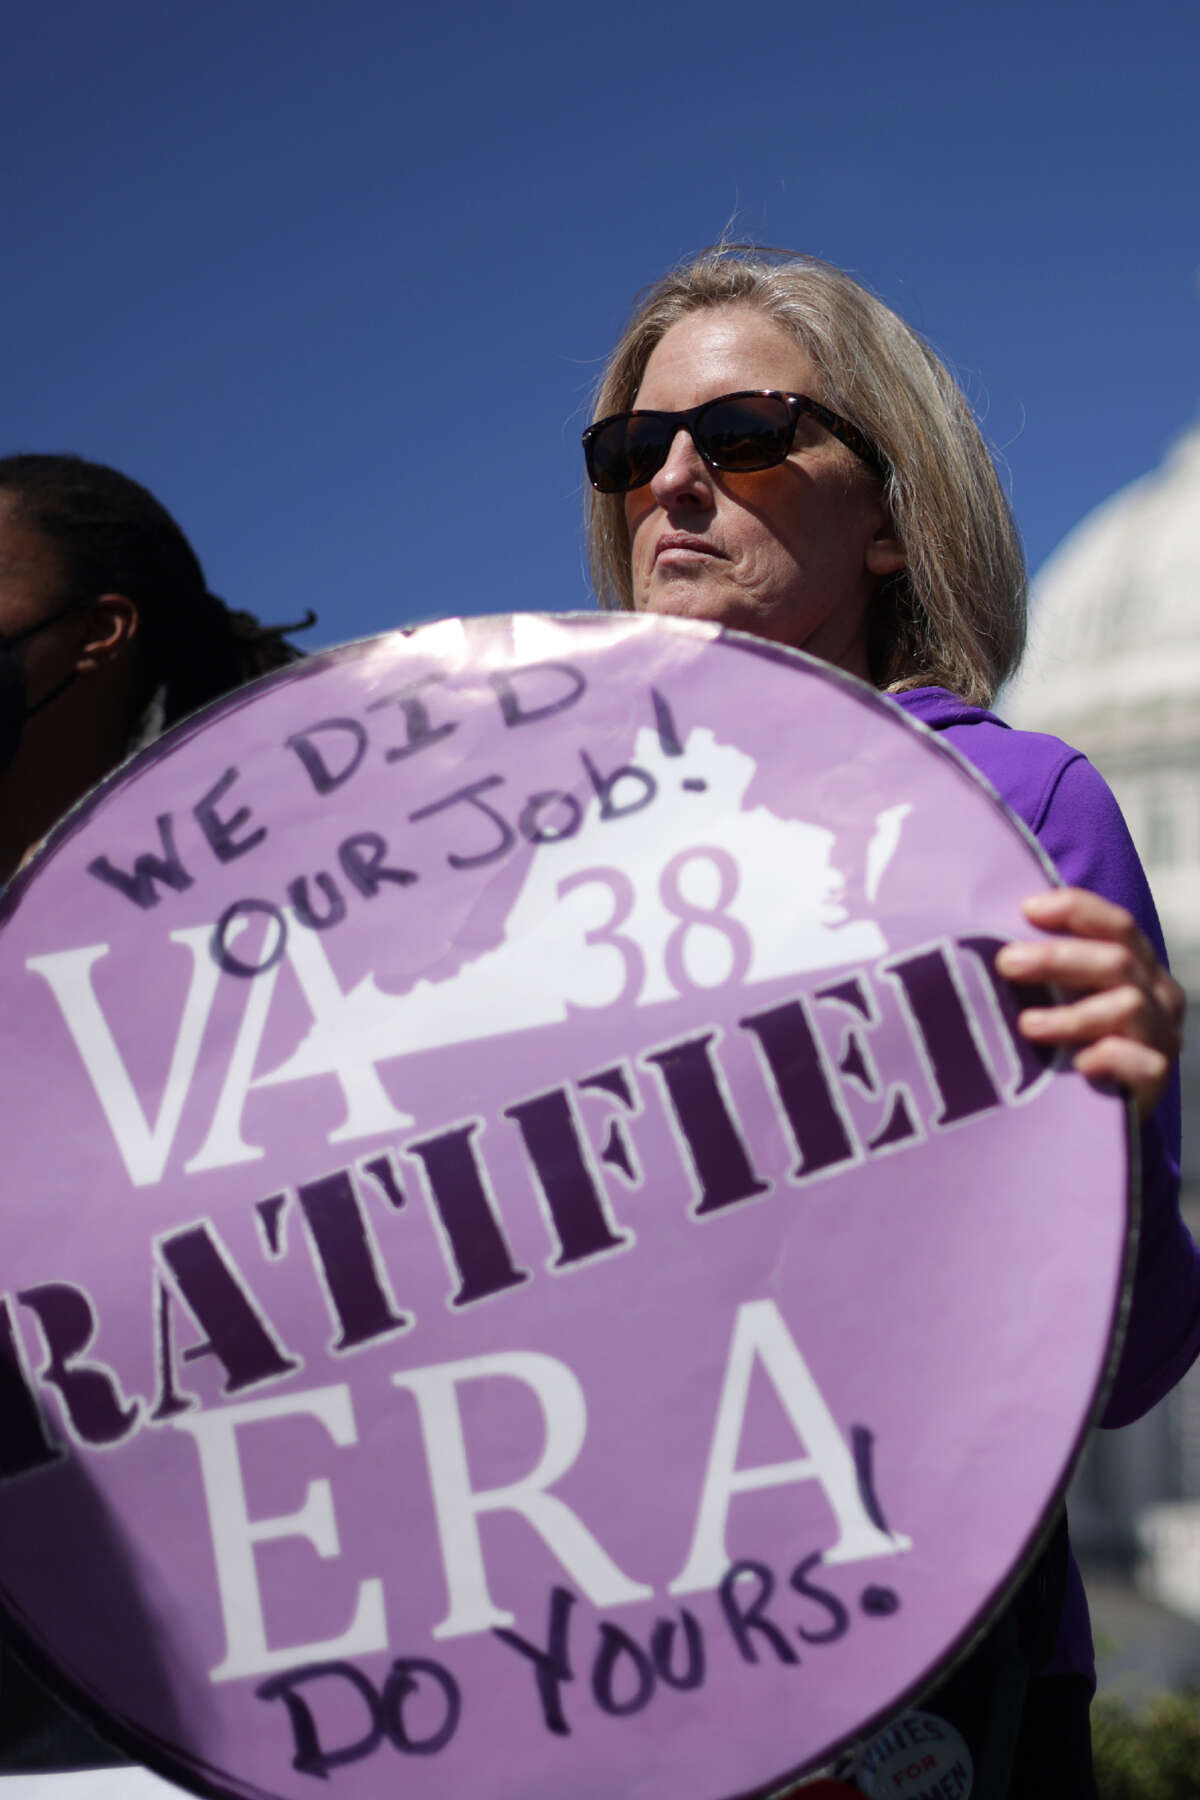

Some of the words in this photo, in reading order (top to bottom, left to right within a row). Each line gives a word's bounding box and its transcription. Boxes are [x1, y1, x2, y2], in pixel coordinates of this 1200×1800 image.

[87, 766, 269, 910] WE
[283, 661, 588, 797] DID
[209, 831, 419, 979] OUR
[25, 902, 416, 1187] VA
[555, 844, 754, 1008] 38
[0, 932, 1060, 1482] RATIFIED
[172, 1298, 912, 1683] ERA
[255, 1658, 462, 1780] DO
[892, 1753, 937, 1788] FOR
[906, 1759, 968, 1800] MEN
